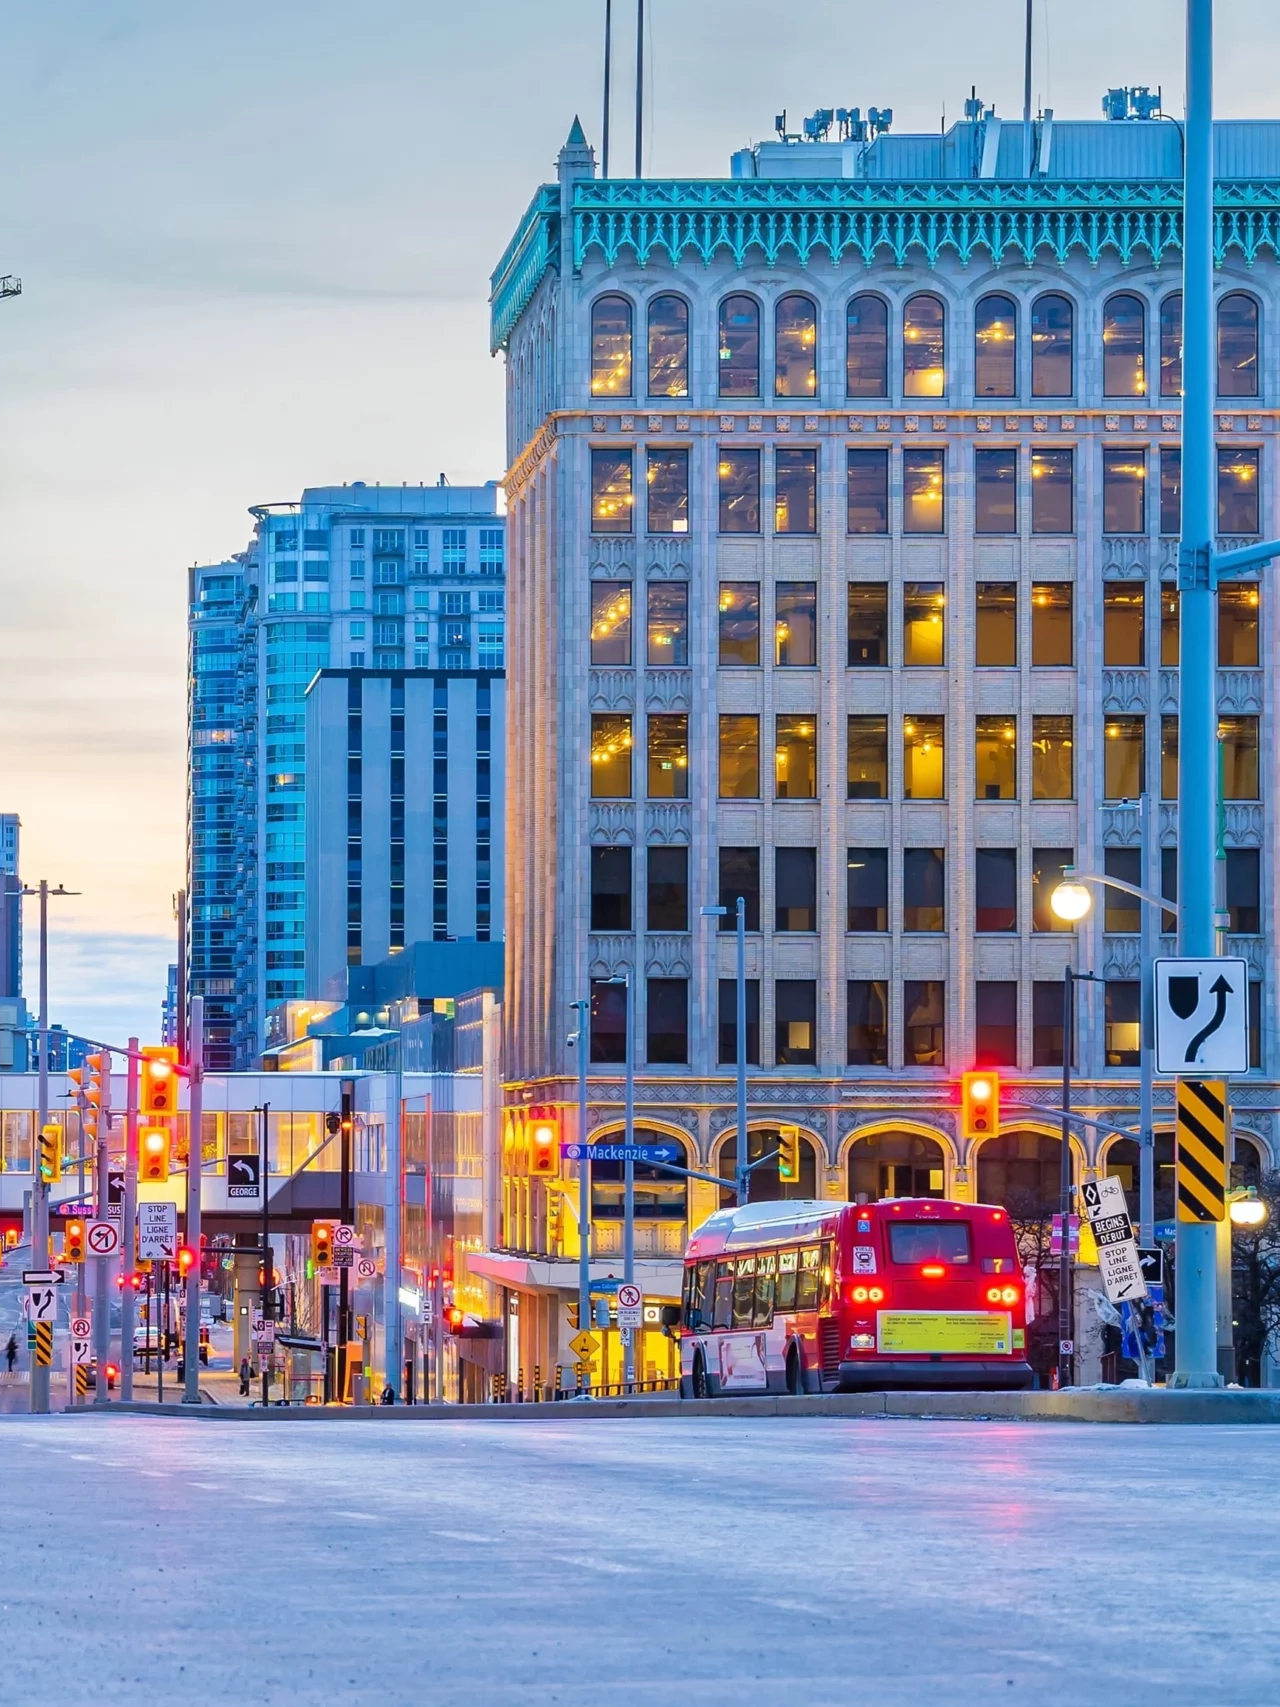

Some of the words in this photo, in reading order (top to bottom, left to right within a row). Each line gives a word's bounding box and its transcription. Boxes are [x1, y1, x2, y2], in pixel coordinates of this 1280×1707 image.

[586, 1145, 648, 1160] Mackenzie
[230, 1187, 257, 1196] GEORGE
[107, 1205, 121, 1214] SUS
[147, 1205, 168, 1213] STOP
[149, 1214, 167, 1222] LINE
[1094, 1215, 1125, 1233] BEGINS
[146, 1225, 169, 1234] LIGNE
[141, 1234, 174, 1243] D'ARRÊT
[1105, 1246, 1128, 1258] STOP
[1108, 1255, 1128, 1266] LINE
[993, 1258, 1003, 1274] 7
[1107, 1264, 1134, 1277] LIGNE
